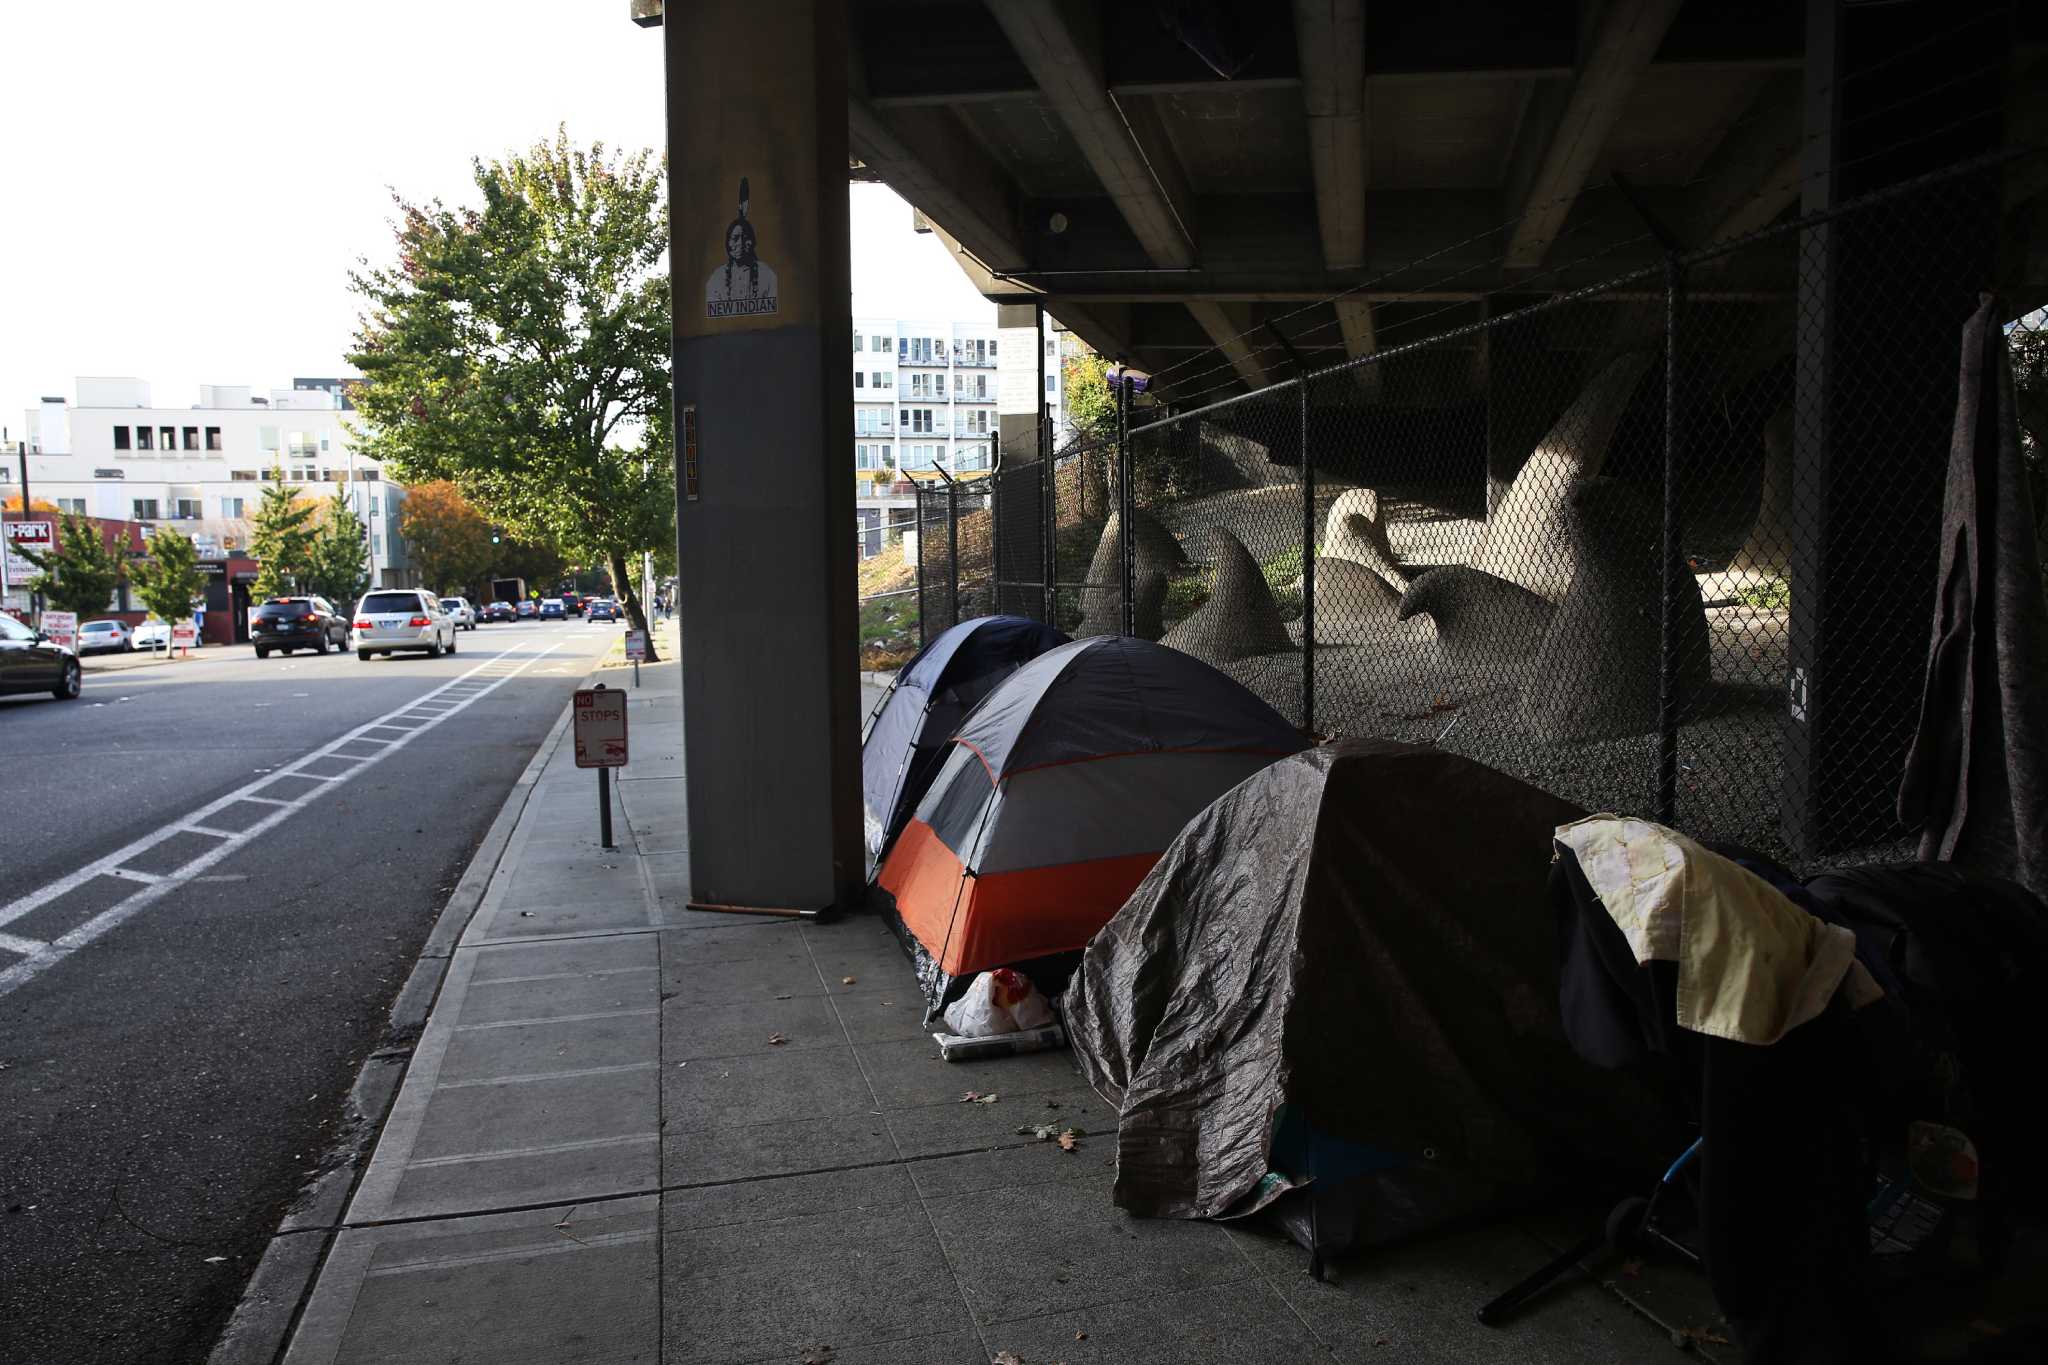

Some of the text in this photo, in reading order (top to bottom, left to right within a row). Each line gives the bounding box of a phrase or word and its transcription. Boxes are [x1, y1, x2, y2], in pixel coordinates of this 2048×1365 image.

[707, 297, 776, 317] NEW INDIAN
[576, 695, 592, 706] NO
[581, 709, 620, 721] STOPS
